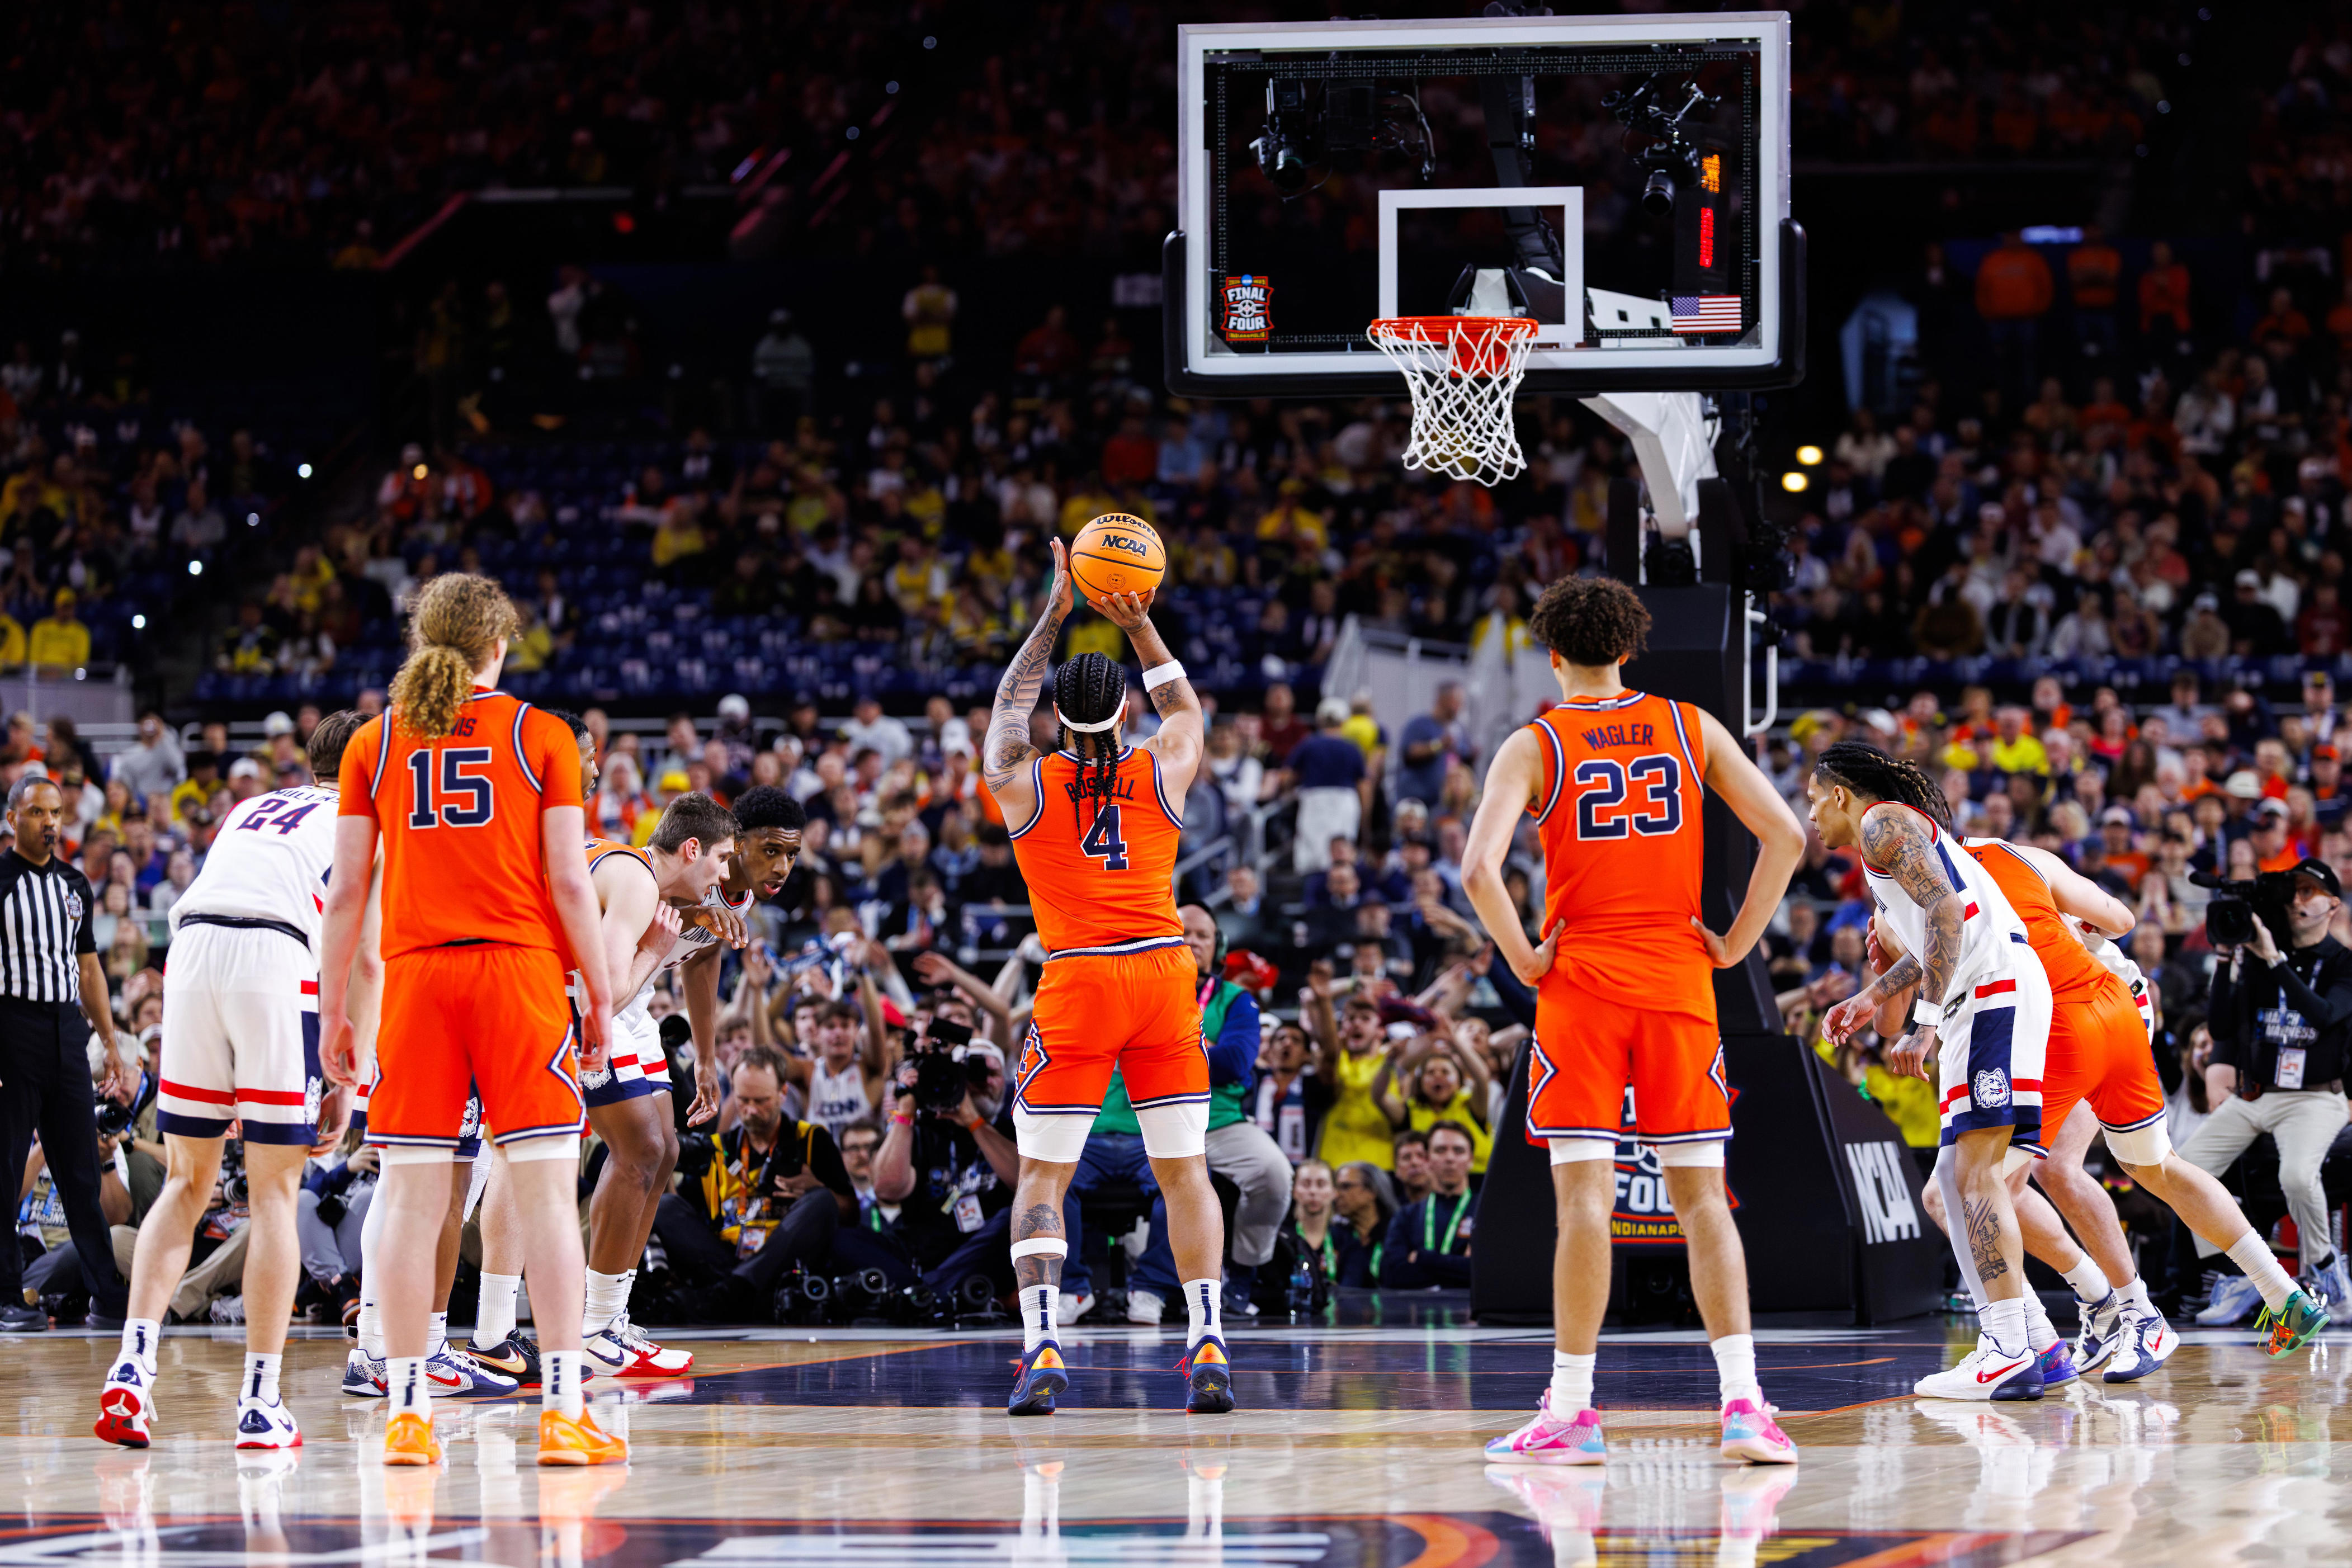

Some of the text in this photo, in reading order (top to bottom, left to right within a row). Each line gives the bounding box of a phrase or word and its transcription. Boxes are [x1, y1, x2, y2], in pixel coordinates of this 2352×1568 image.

[1227, 286, 1265, 302] FINAL
[1228, 316, 1266, 330] FOUR
[1101, 534, 1147, 557] NCAA
[450, 717, 478, 736] VIS
[1581, 724, 1654, 751] WAGLER
[407, 747, 494, 830] 15
[1064, 776, 1135, 803] BOSWLL
[1574, 753, 1683, 842] 23
[235, 799, 320, 835] 24
[1080, 804, 1129, 871] 4
[2264, 1010, 2301, 1026] MACH
[1614, 1171, 1674, 1213] FOU
[1845, 1141, 1921, 1245] NCAA
[1612, 1220, 1685, 1236] NDIANAPO
